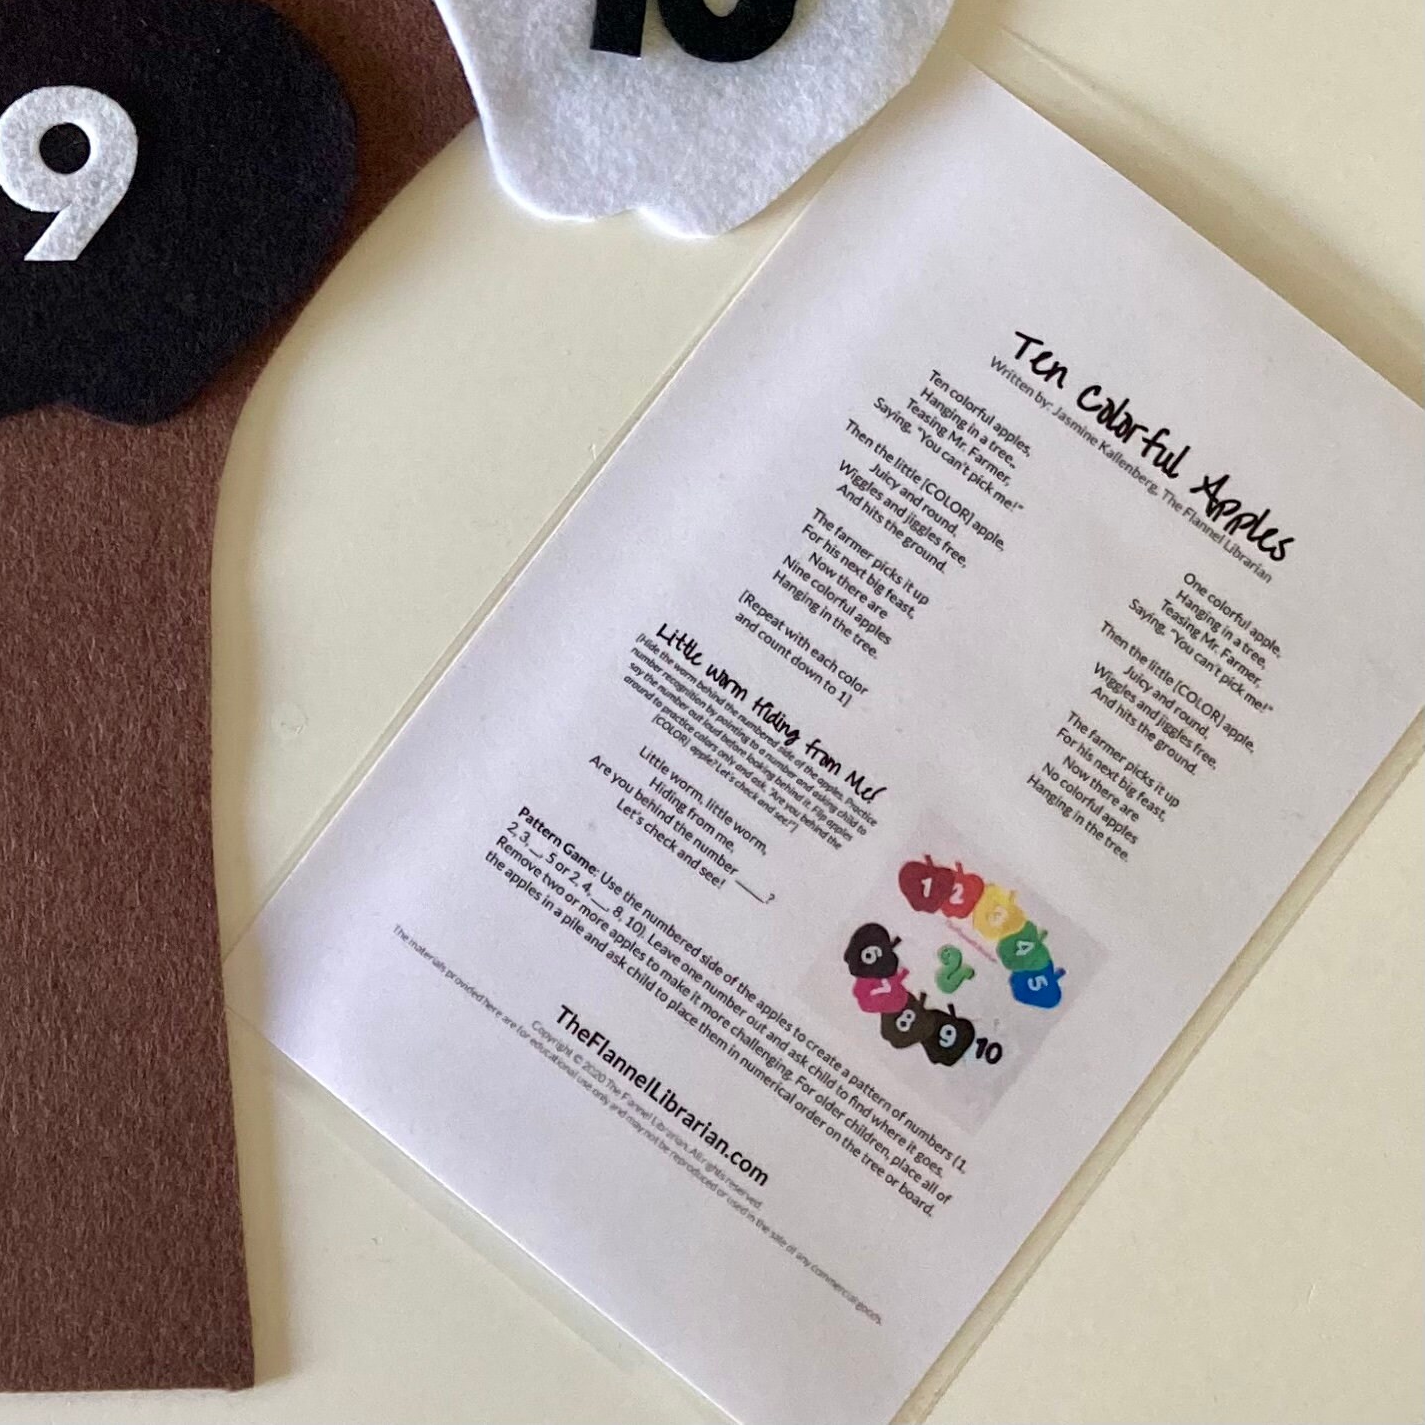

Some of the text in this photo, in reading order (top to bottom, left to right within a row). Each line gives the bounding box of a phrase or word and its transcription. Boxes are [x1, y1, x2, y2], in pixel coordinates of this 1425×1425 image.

[873, 396, 913, 435] Saying,
[940, 450, 971, 476] can't
[966, 471, 995, 495] pick
[906, 397, 1012, 487] Teasing Mr. Farmer,
[919, 386, 969, 431] Hanging
[966, 421, 980, 439] in
[978, 434, 989, 446] a
[928, 368, 1031, 458] Ten colorful apples,
[1013, 330, 1296, 563] Ten Colorful Apples
[838, 459, 967, 569] Wiggles and jiggles free,
[845, 417, 1005, 552] Then the little [COLOR] apple,
[868, 462, 959, 539] Juicy and round,
[990, 355, 1035, 398] Written
[1051, 406, 1099, 448] Jasmine
[1161, 487, 1184, 513] The
[1181, 506, 1227, 545] Flannel
[1222, 538, 1273, 584] Librarian
[801, 523, 916, 620] For his next big feast,
[812, 506, 930, 606] The farmer picks it up
[835, 483, 948, 575] And hits the ground.
[772, 568, 878, 660] Hanging in the tree.
[781, 554, 893, 646] Nine colorful apples
[807, 551, 889, 620] Now there are
[1175, 589, 1266, 671] Hanging in a tree,
[1183, 572, 1281, 659] One colorful apple,
[1128, 598, 1167, 637] Saying,
[1193, 652, 1223, 678] can't
[1218, 673, 1246, 697] pick
[1160, 598, 1263, 689] Teasing Mr. Farmer,
[655, 622, 888, 805] Little worm Hiding from Me!
[588, 754, 740, 876] Are you behind the number
[615, 797, 727, 890] Let's check and see!
[638, 744, 767, 856] Little worm, little worm,
[648, 775, 735, 854] Hiding from me,
[921, 878, 932, 898] 1
[517, 805, 563, 848] Pattern
[562, 842, 601, 878] Game:
[599, 870, 623, 896] Use
[622, 890, 643, 912] the
[641, 908, 703, 958] numbered
[698, 954, 724, 977] side
[722, 973, 740, 987] of
[736, 981, 757, 1003] the
[755, 999, 794, 1033] apples
[792, 1026, 807, 1043] to
[805, 1039, 843, 1072] create
[840, 1068, 851, 1079] a
[847, 1074, 893, 1113] pattern
[891, 1108, 908, 1122] of
[903, 1118, 954, 1161] numbers
[530, 1019, 575, 1059] Copyright
[939, 1024, 956, 1047] 9
[976, 1038, 1003, 1064] 10
[556, 1003, 769, 1187] TheFlannelLibrarian.com
